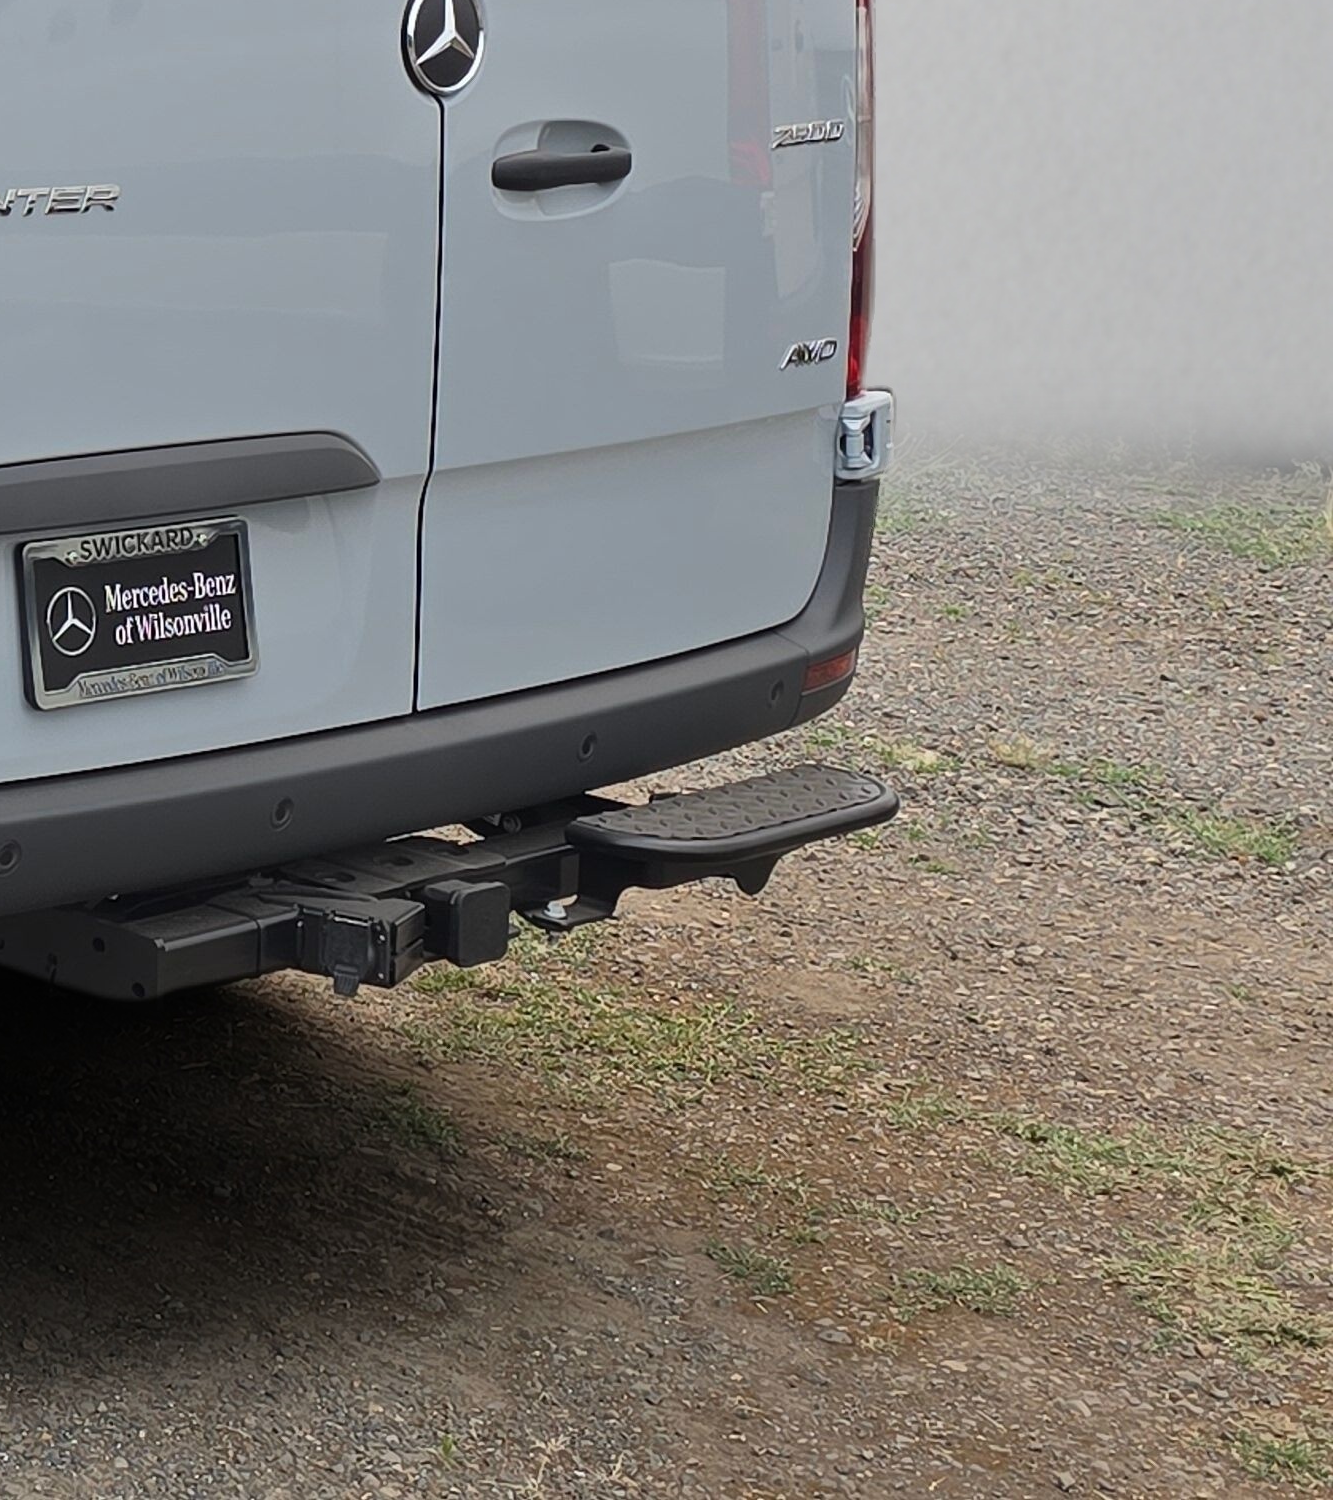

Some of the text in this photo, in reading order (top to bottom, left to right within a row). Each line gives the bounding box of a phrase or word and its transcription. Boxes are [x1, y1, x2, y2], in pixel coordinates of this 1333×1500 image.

[779, 337, 837, 371] AWD
[80, 527, 194, 560] SWICKARD
[104, 571, 237, 614] Mercedes-Benz
[115, 603, 232, 646] of Wilsonville
